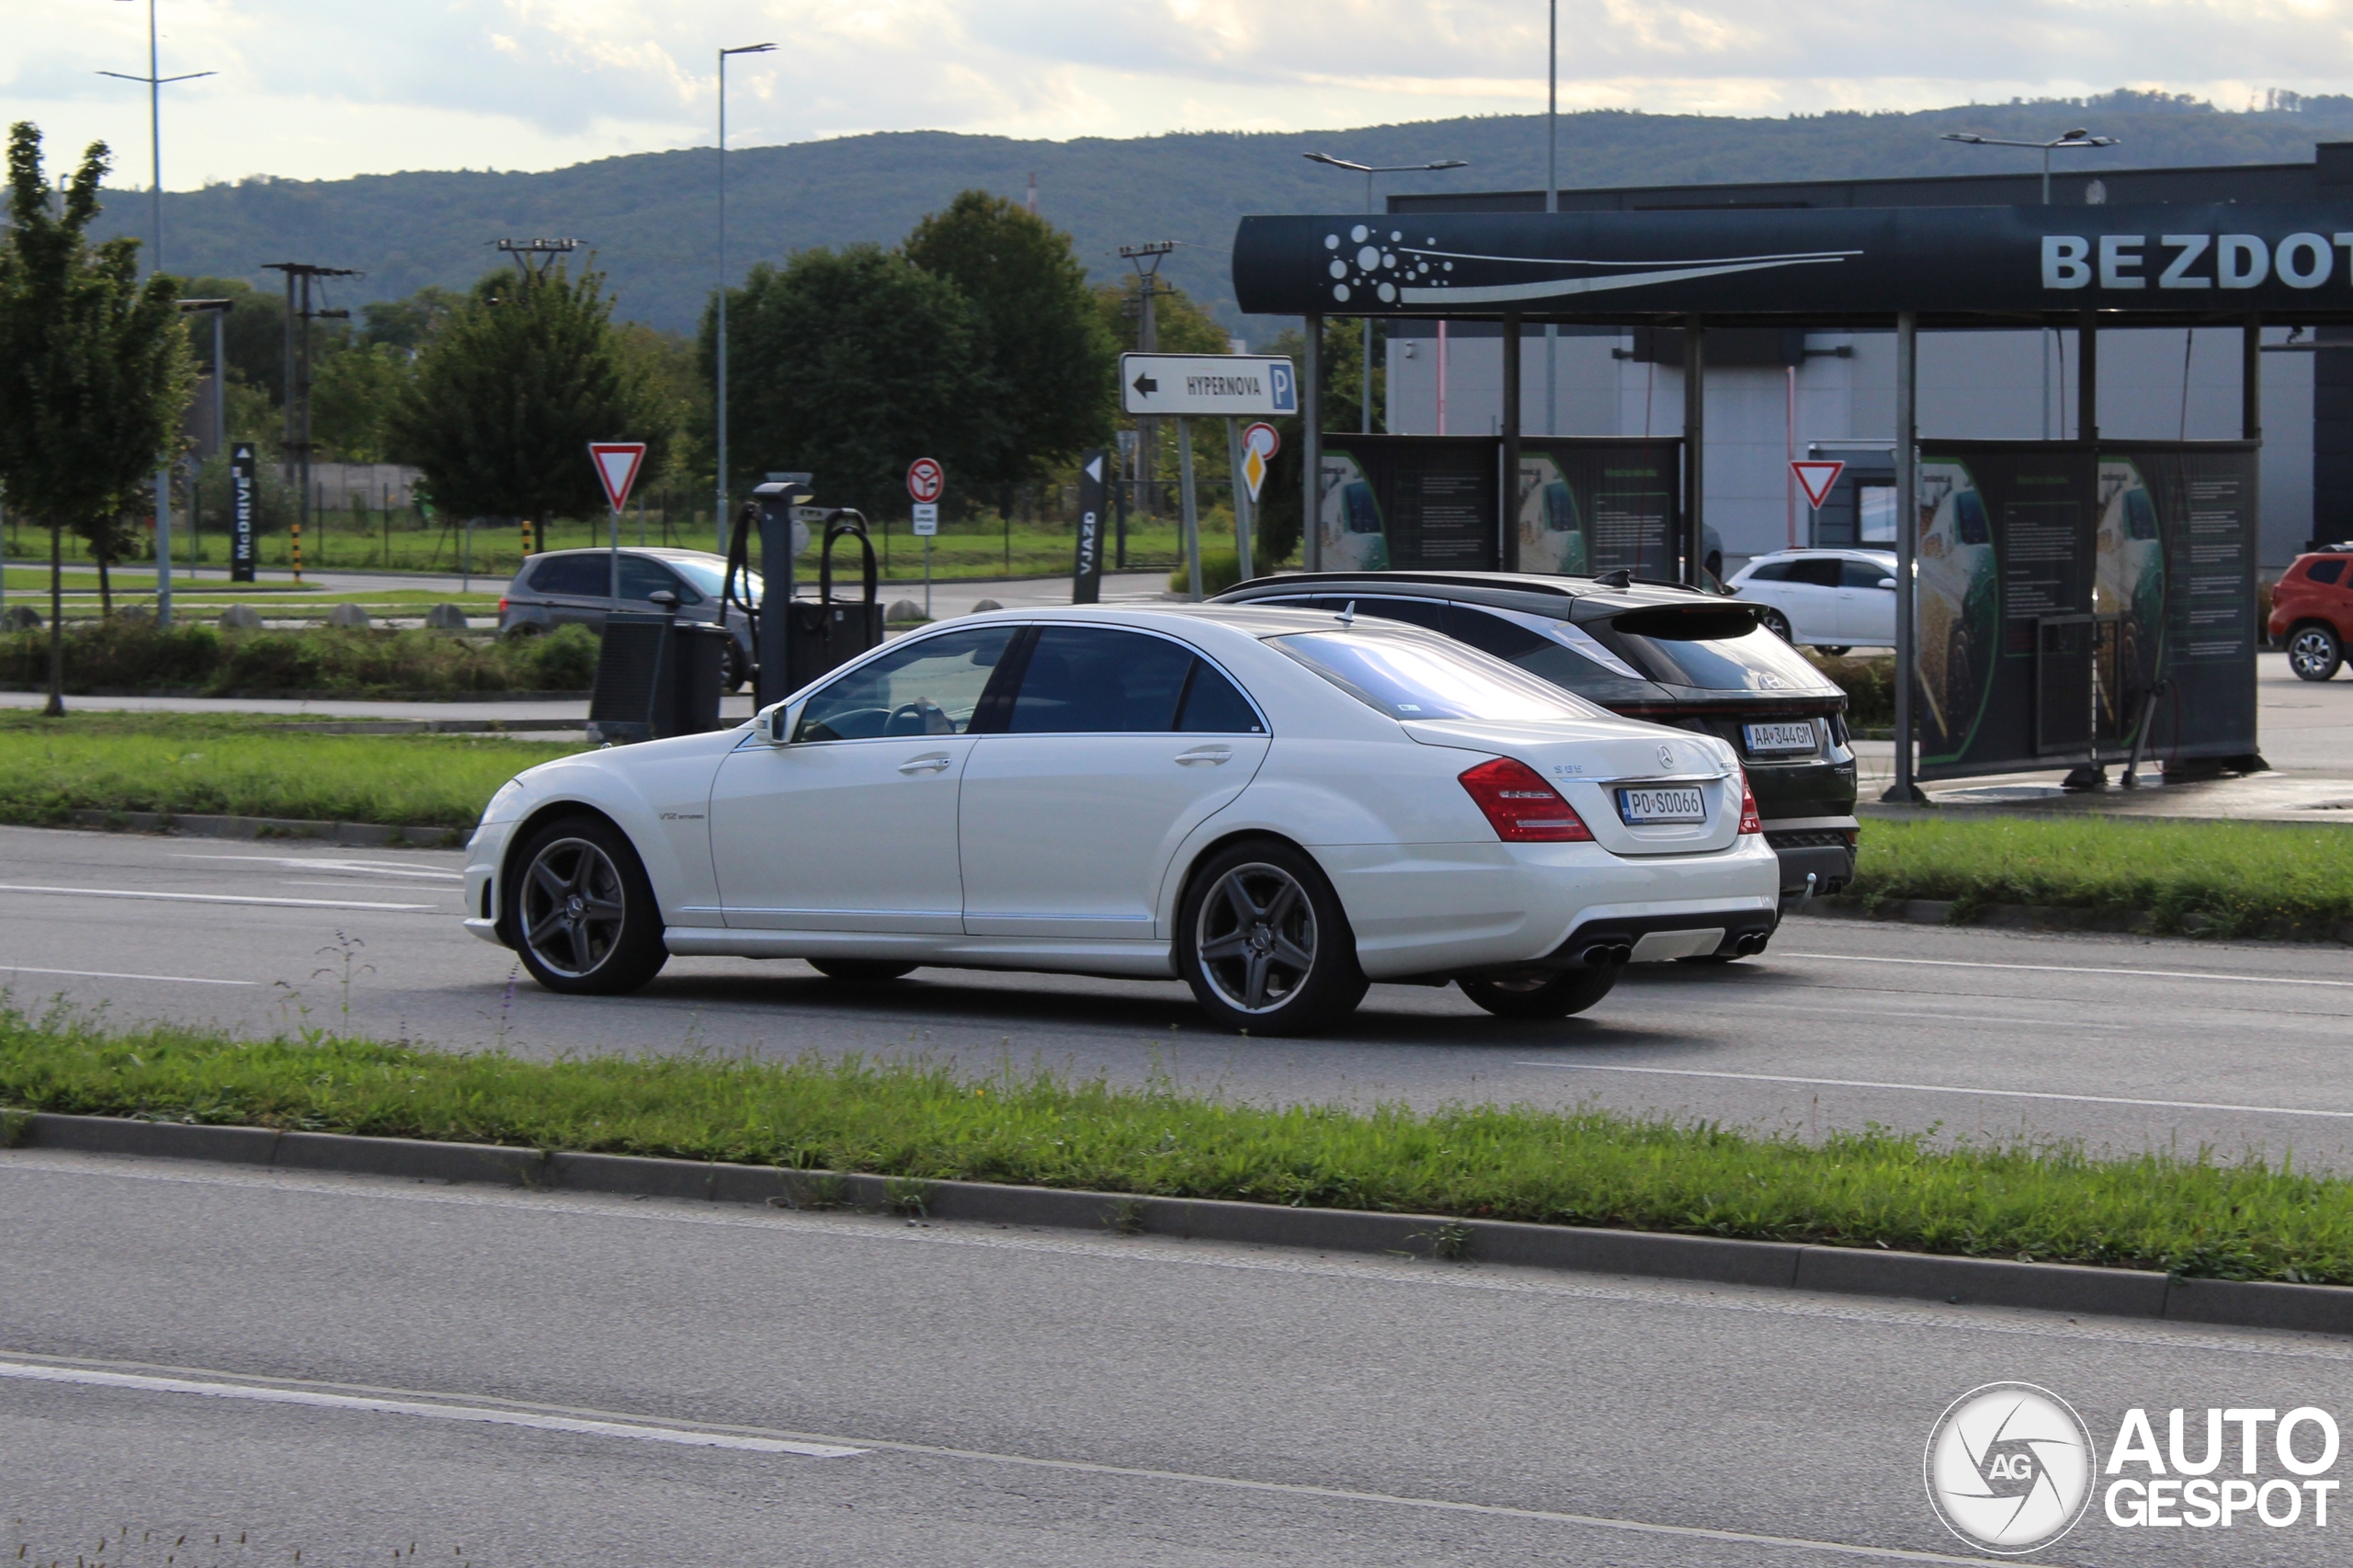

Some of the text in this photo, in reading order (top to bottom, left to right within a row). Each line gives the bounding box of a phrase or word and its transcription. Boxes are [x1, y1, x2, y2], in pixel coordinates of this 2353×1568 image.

[1187, 369, 1288, 404] HYPERNOVA P
[237, 476, 251, 560] McDRIVE
[1080, 511, 1097, 575] VJAZD
